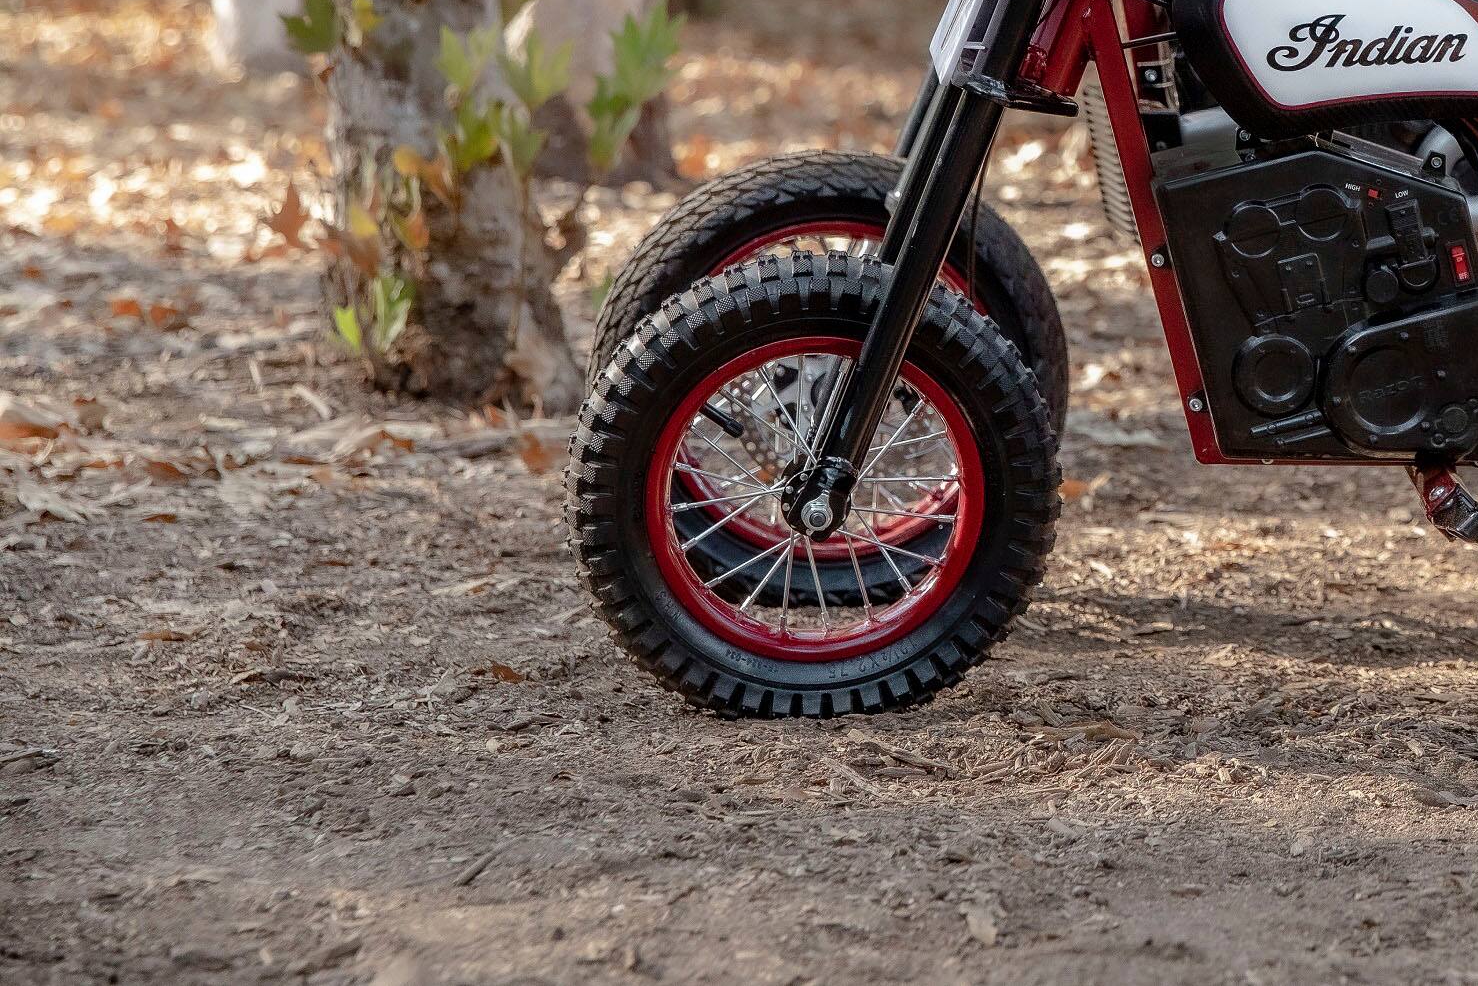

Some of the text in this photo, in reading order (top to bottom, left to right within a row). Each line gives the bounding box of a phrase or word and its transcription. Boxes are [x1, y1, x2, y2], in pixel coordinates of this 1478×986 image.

[1267, 14, 1468, 71] Indian
[1345, 182, 1361, 192] HIGH
[1395, 189, 1409, 199] LOW
